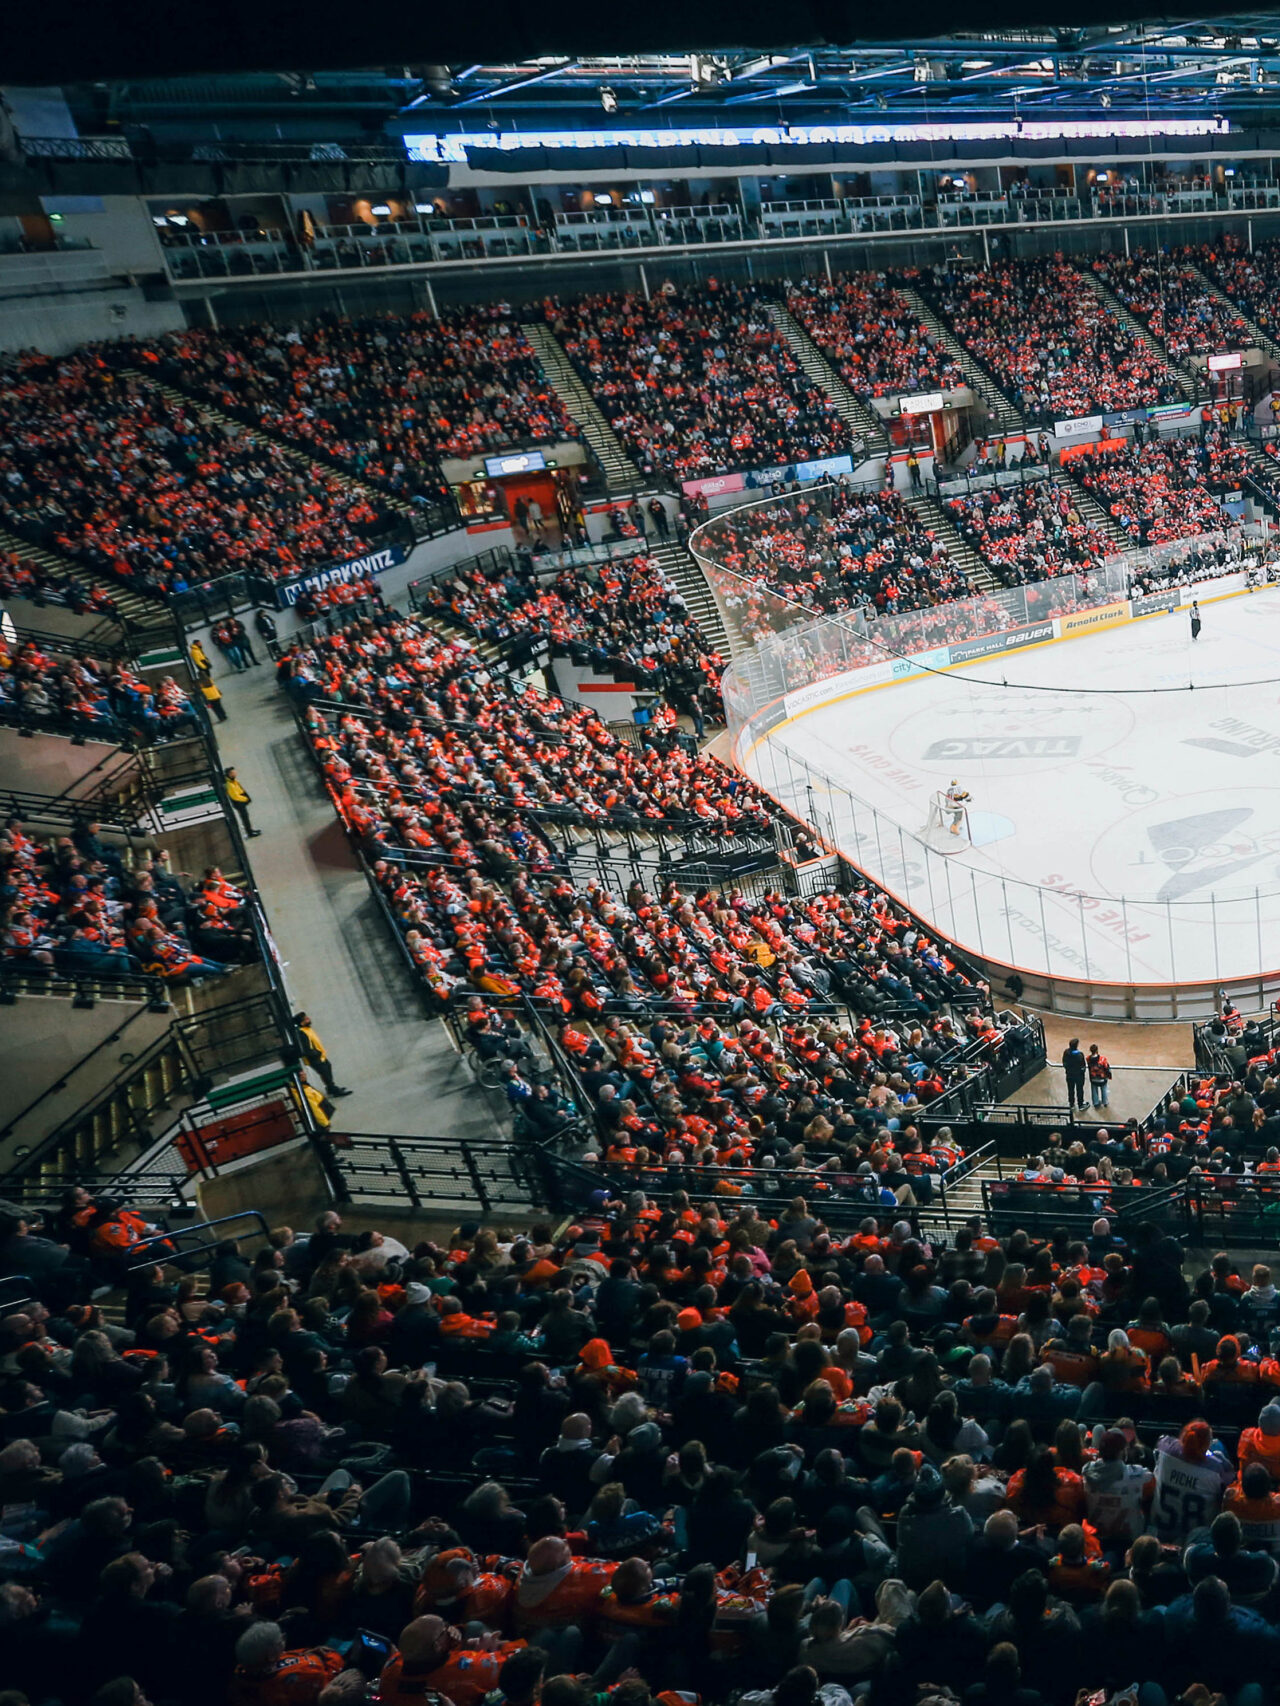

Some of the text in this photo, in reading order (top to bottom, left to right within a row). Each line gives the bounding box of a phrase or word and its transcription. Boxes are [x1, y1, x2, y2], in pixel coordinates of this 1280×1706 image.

[305, 549, 395, 592] MARKOVITZ
[1065, 609, 1124, 630] Arnold Clark
[967, 626, 1053, 656] PARK HALL BAUER
[893, 662, 912, 673] city
[847, 743, 925, 792] FIVE GUYS
[1039, 872, 1152, 945] FIVE GUYS
[1169, 1468, 1200, 1490] PICHE
[1160, 1484, 1206, 1533] 58
